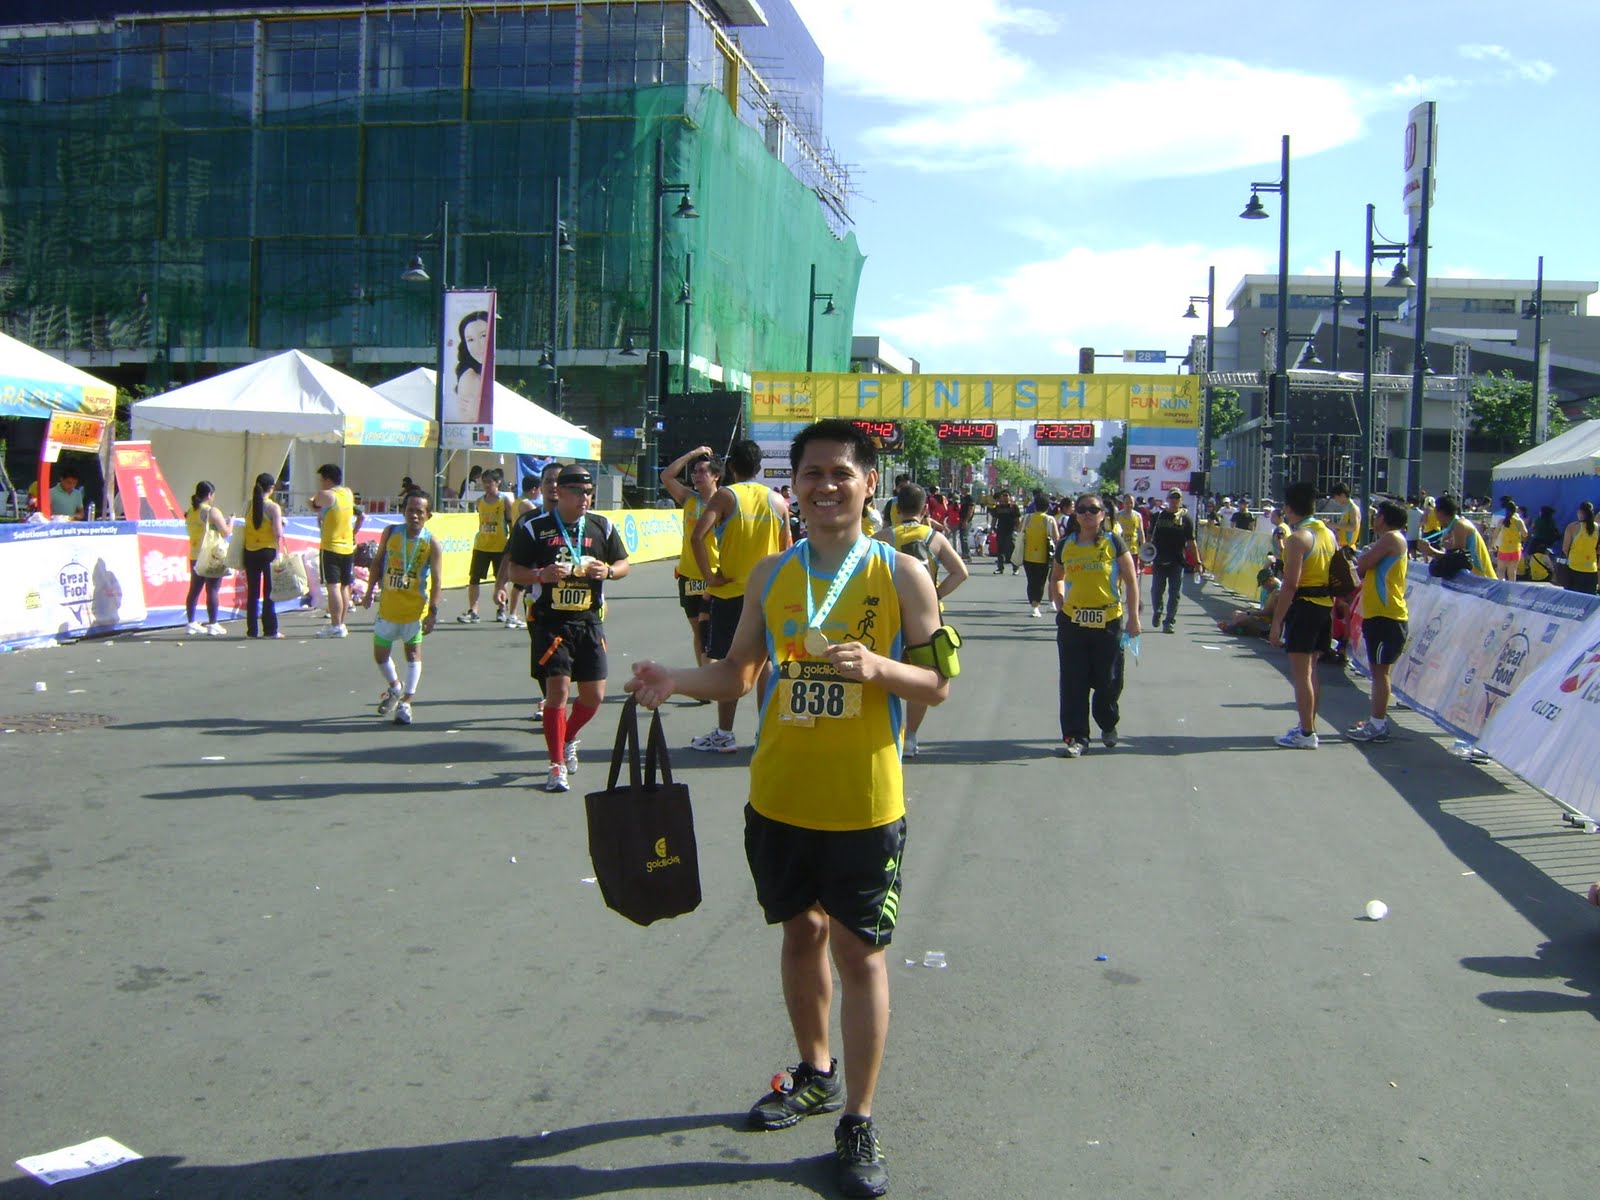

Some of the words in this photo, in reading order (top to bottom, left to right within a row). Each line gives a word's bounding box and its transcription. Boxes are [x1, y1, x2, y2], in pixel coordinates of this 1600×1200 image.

[858, 379, 1087, 409] FINISH
[938, 424, 994, 438] 2:44:40
[1036, 424, 1091, 438] 2:25:20
[13, 530, 49, 540] Solutions
[49, 528, 63, 537] that
[77, 529, 90, 537] you
[90, 526, 118, 536] perfectly
[60, 571, 89, 585] Great
[63, 584, 88, 598] Food
[558, 589, 587, 605] 1007
[1075, 610, 1103, 624] 2005
[1499, 643, 1527, 667] Great
[1491, 662, 1517, 686] Food
[791, 680, 845, 717] 838
